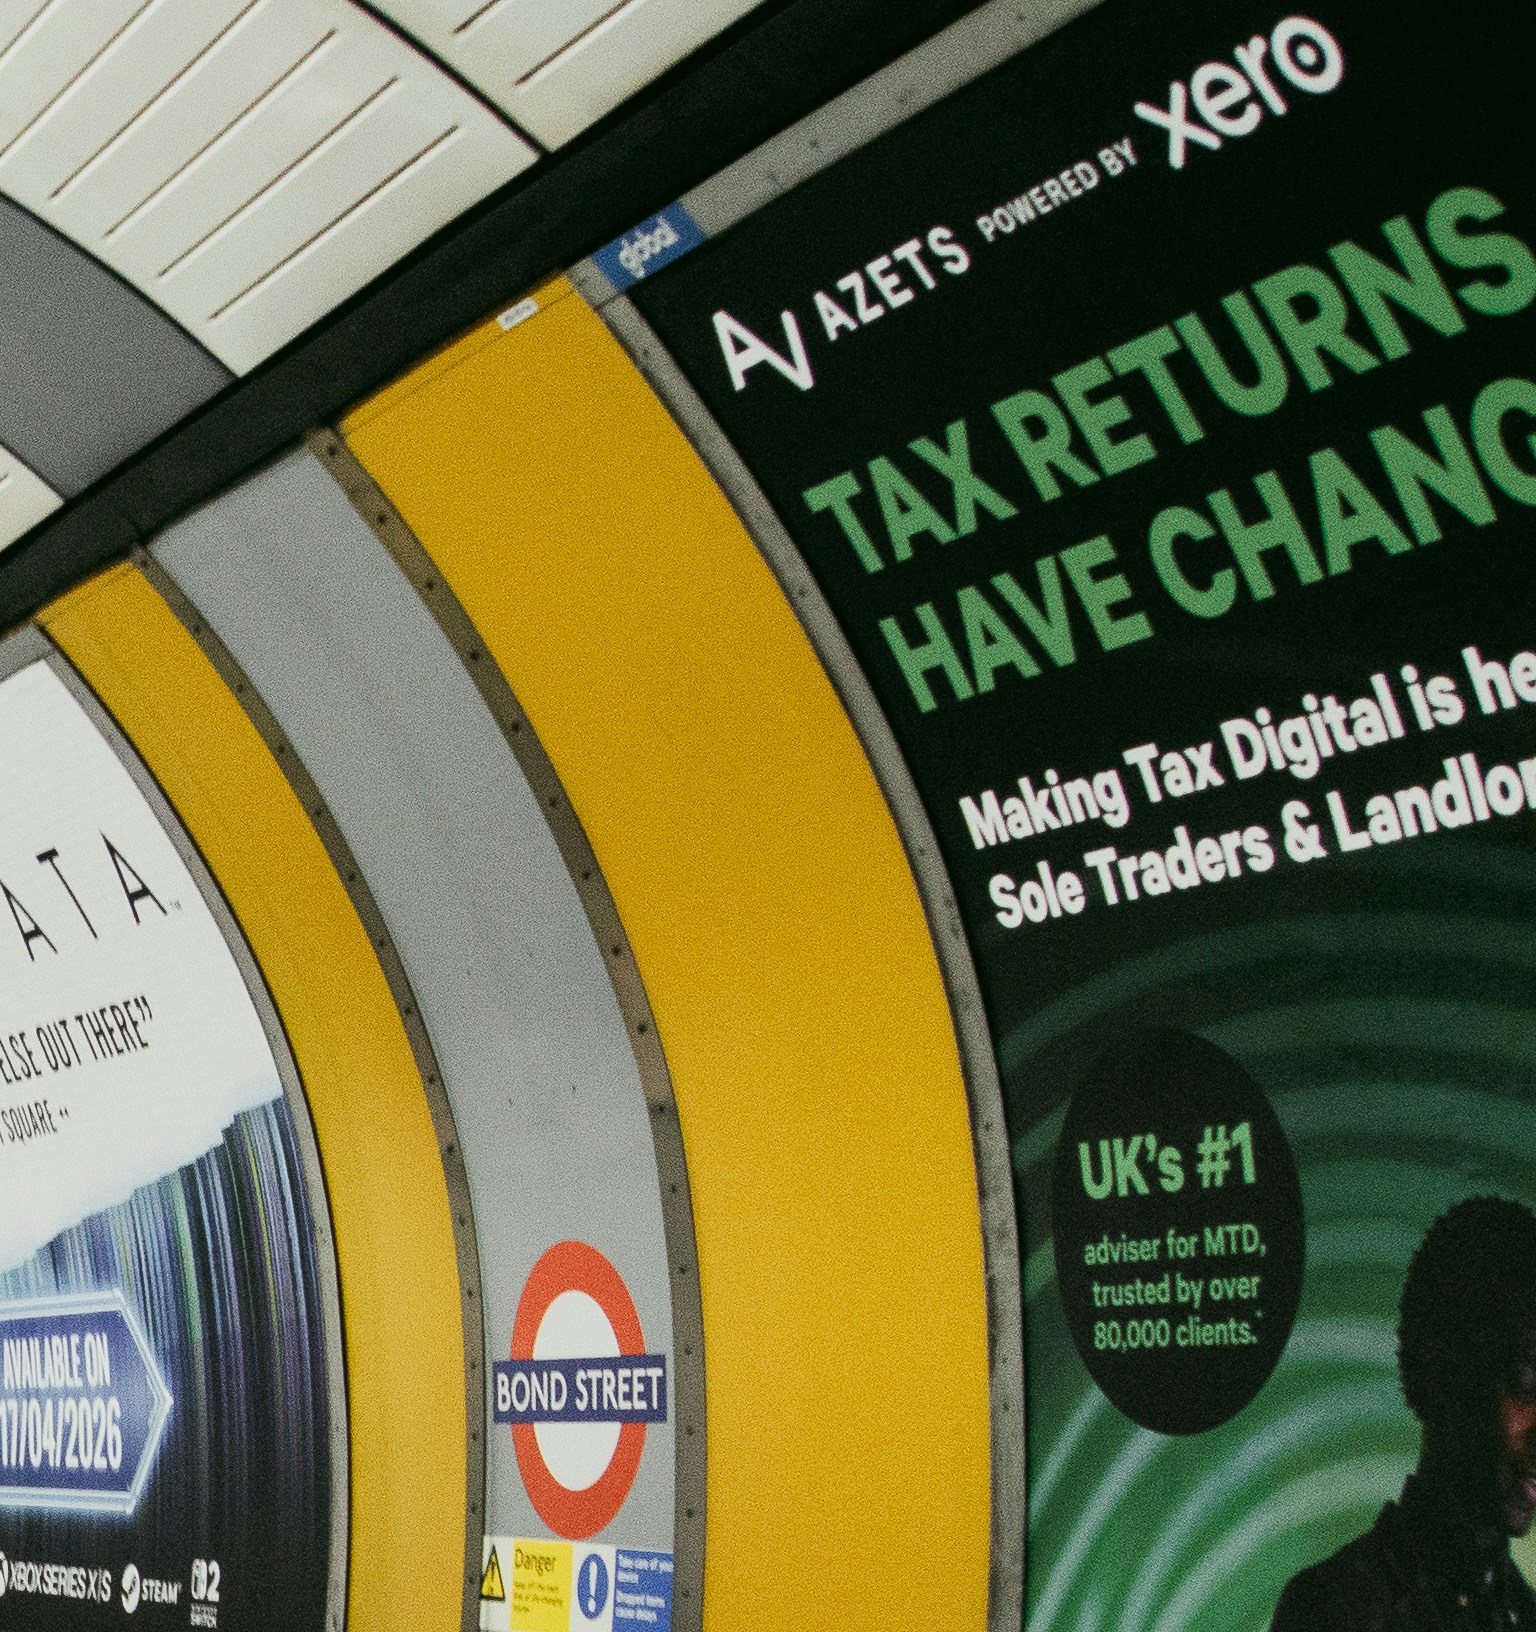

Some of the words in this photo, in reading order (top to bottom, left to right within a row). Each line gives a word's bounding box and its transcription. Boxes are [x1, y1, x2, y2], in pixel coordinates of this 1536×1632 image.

[813, 226, 971, 341] AZETS
[977, 161, 1101, 243] POWERED
[1099, 138, 1139, 184] BY
[1133, 15, 1346, 169] xero
[619, 216, 679, 278] global
[802, 419, 1018, 573] TAX
[991, 187, 1536, 501] RETURNS
[878, 535, 1154, 713] HAVE
[961, 768, 1131, 849] Making
[1124, 740, 1225, 803] Tax
[1221, 673, 1405, 780] Digital
[1401, 664, 1465, 731] is
[988, 854, 1086, 929] Sole
[1085, 815, 1275, 908] Traders
[1281, 800, 1327, 863] &
[36, 1019, 82, 1073] OUT
[1, 1100, 58, 1145] SQUARE
[1197, 1121, 1257, 1188] #1
[1084, 1231, 1161, 1265] adviser
[1167, 1228, 1199, 1259] for
[1205, 1223, 1266, 1257] MTD,
[1093, 1273, 1170, 1307] trusted
[1176, 1272, 1203, 1309] by
[1210, 1275, 1259, 1301] over
[3, 1333, 83, 1390] AVAILABLE
[84, 1332, 111, 1387] ON
[1094, 1320, 1170, 1352] 80,000
[496, 1370, 568, 1414] BOND
[575, 1366, 663, 1411] STREET
[9, 1561, 43, 1593] XBOX
[43, 1564, 86, 1600] SERIES
[515, 1548, 557, 1577] Danger
[142, 1578, 178, 1604] STEAM
